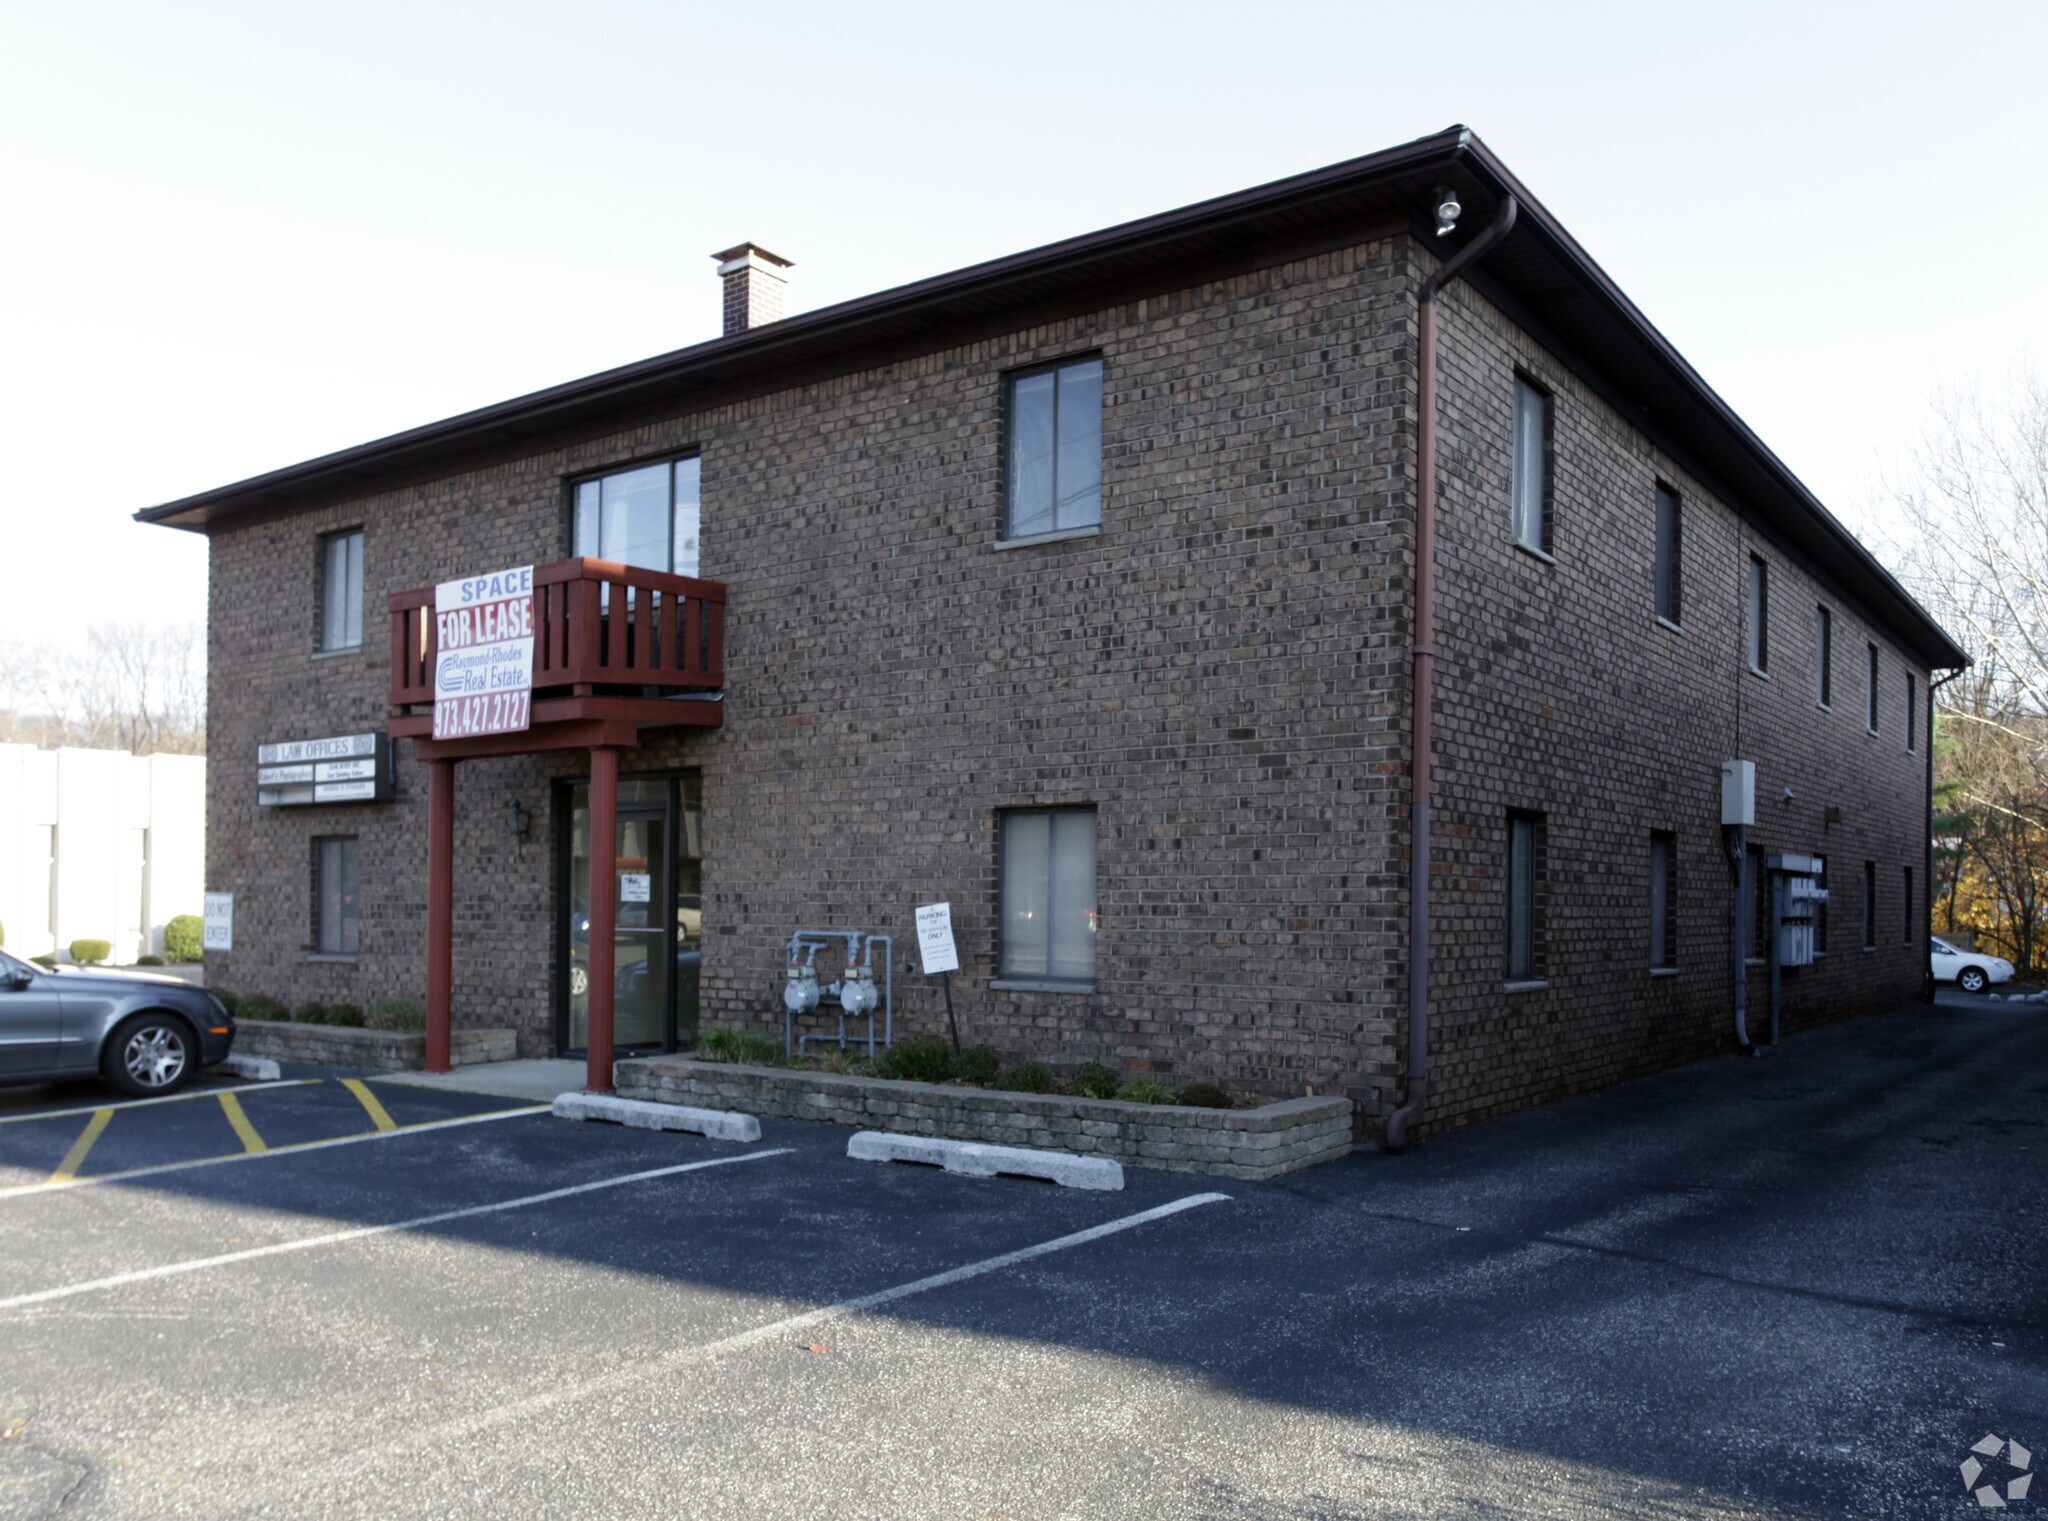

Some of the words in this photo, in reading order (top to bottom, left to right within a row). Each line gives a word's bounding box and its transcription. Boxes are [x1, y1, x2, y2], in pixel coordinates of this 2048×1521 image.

[461, 569, 531, 602] SPACE
[437, 608, 471, 650] FOR
[475, 598, 532, 645] LEASE
[451, 643, 522, 674] Raymond-Rhodes
[464, 668, 487, 693] Real
[490, 665, 523, 689] Estate
[435, 690, 529, 739] 973.427.2727
[281, 743, 302, 760] LAW
[305, 739, 349, 757] OFFICES
[205, 902, 215, 917] DO
[217, 902, 230, 917] NOT
[918, 910, 947, 921] PARKING
[206, 925, 229, 941] ENTER
[928, 931, 943, 941] ONLY
